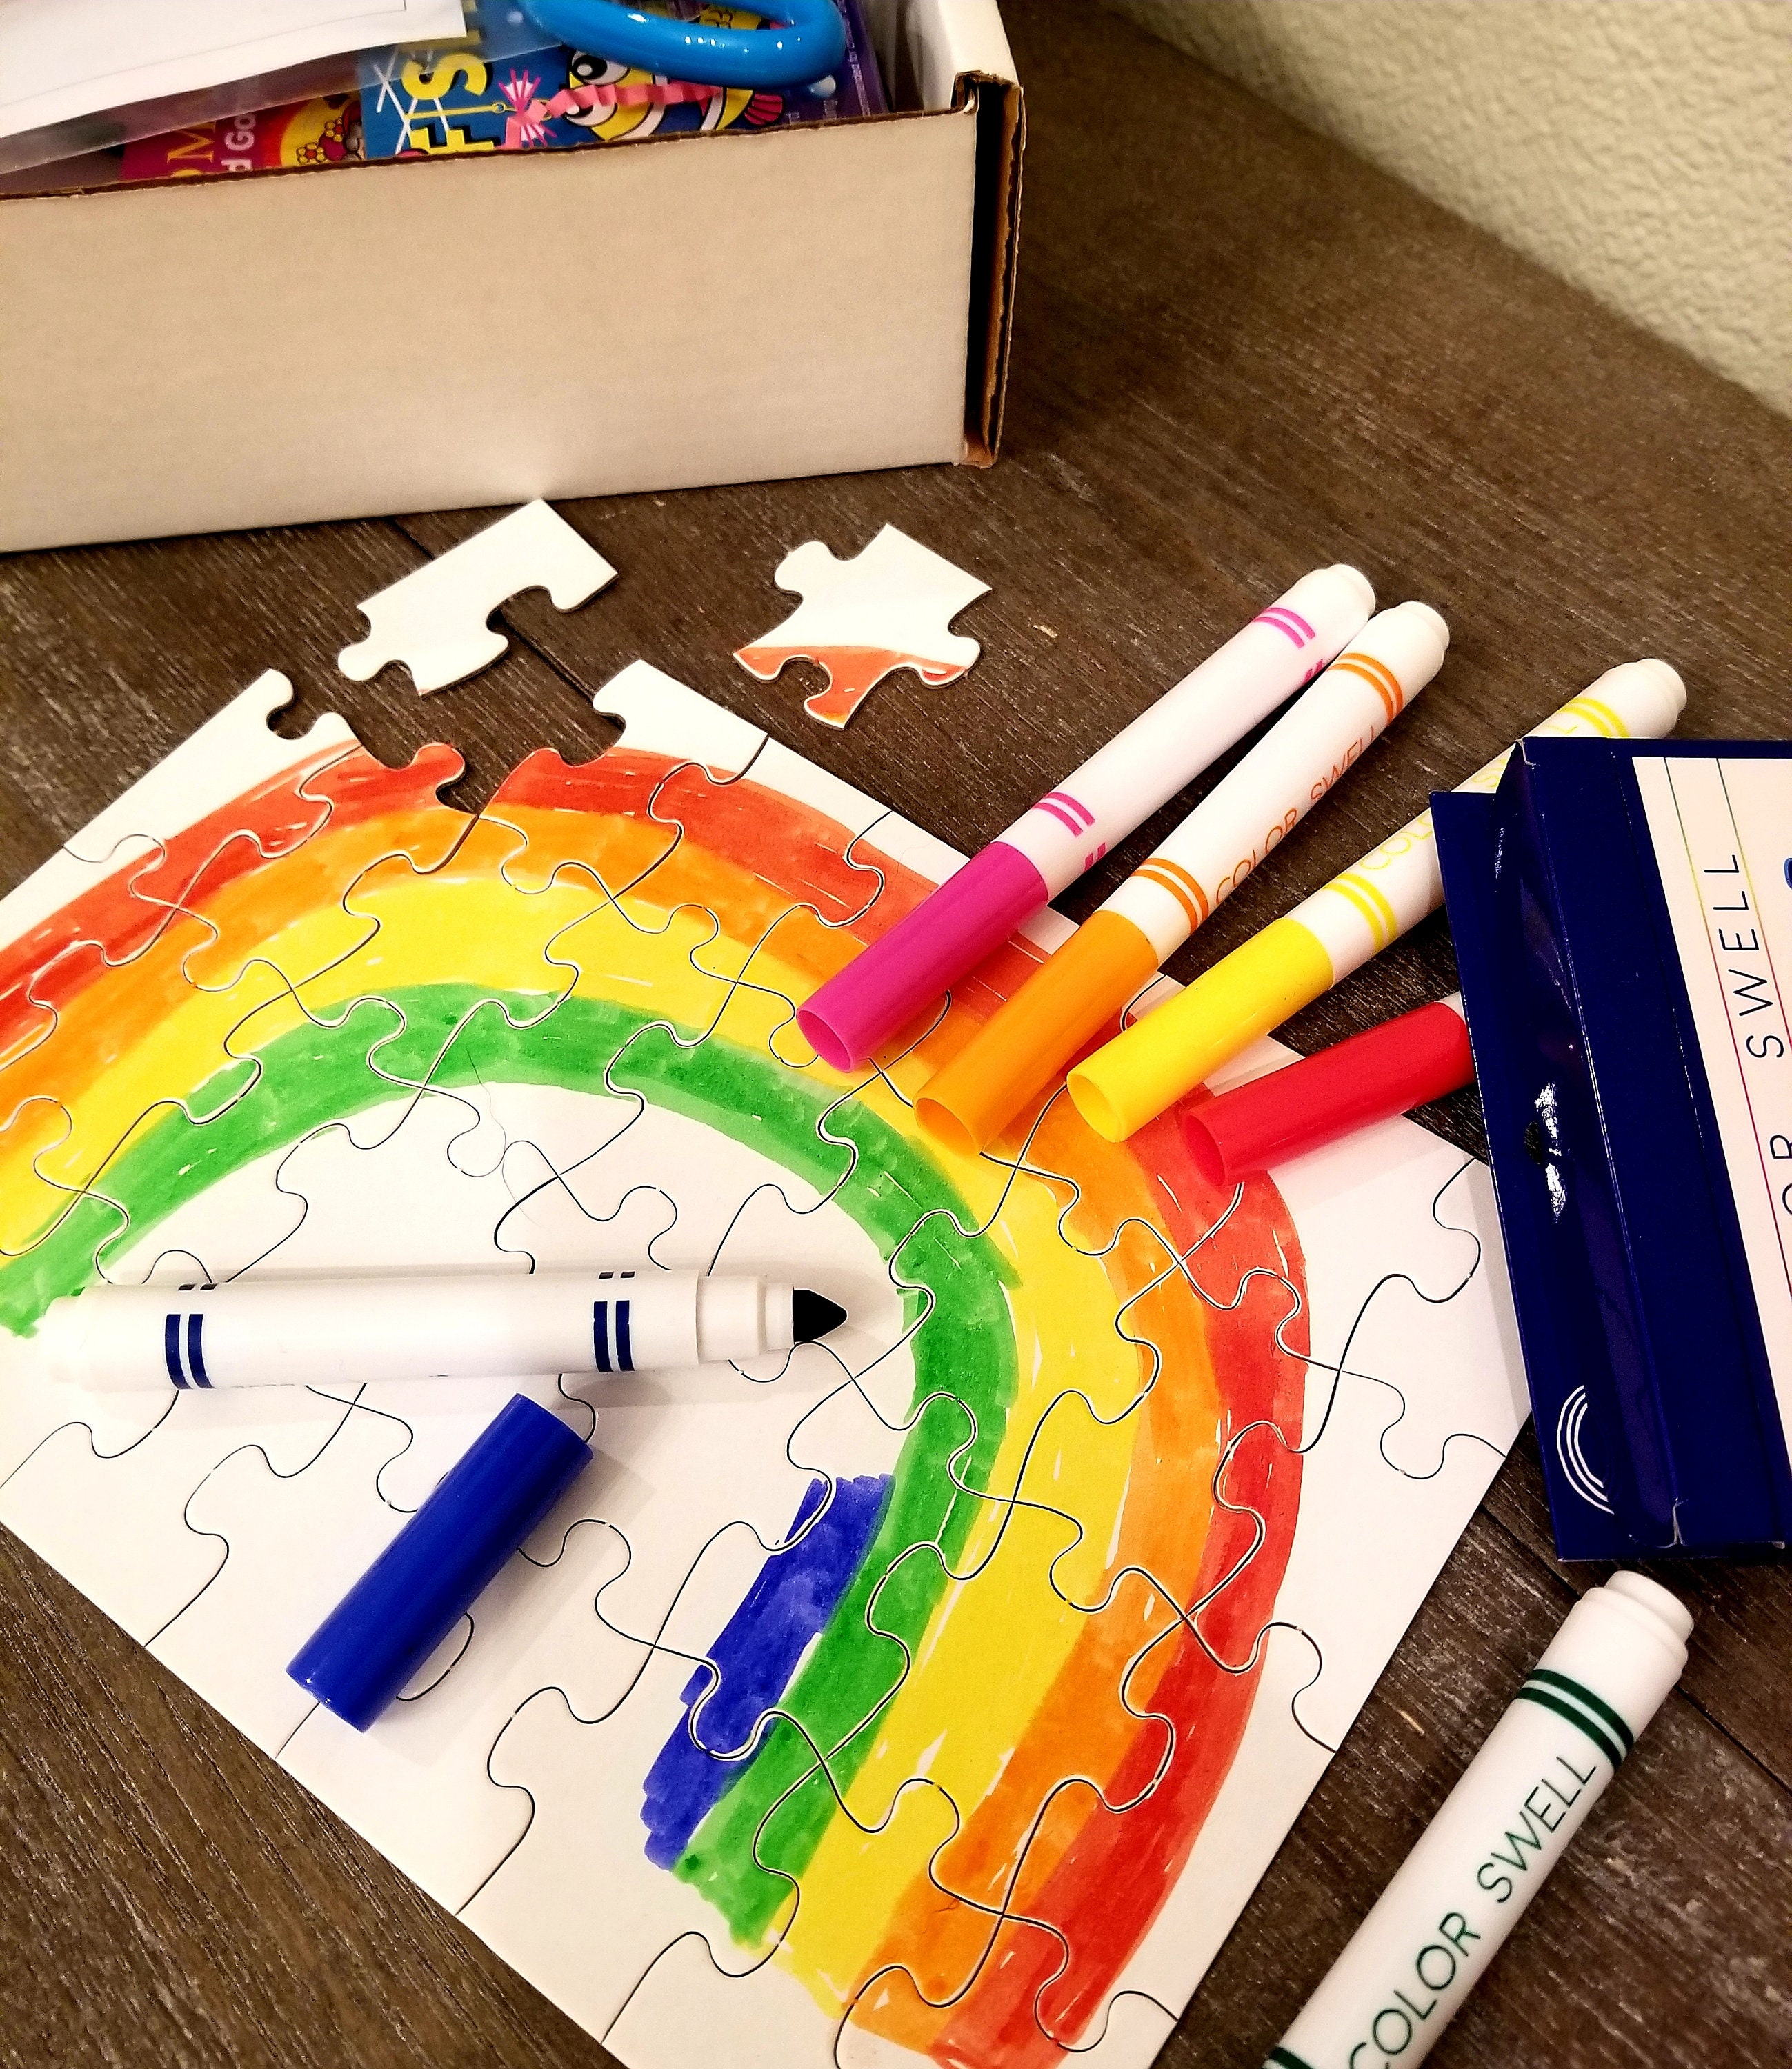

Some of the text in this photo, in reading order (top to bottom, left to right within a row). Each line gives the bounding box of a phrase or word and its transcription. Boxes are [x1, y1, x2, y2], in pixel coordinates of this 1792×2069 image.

[1704, 854, 1784, 1059] SWELL
[1349, 1756, 1597, 2069] COLOR SWELL
